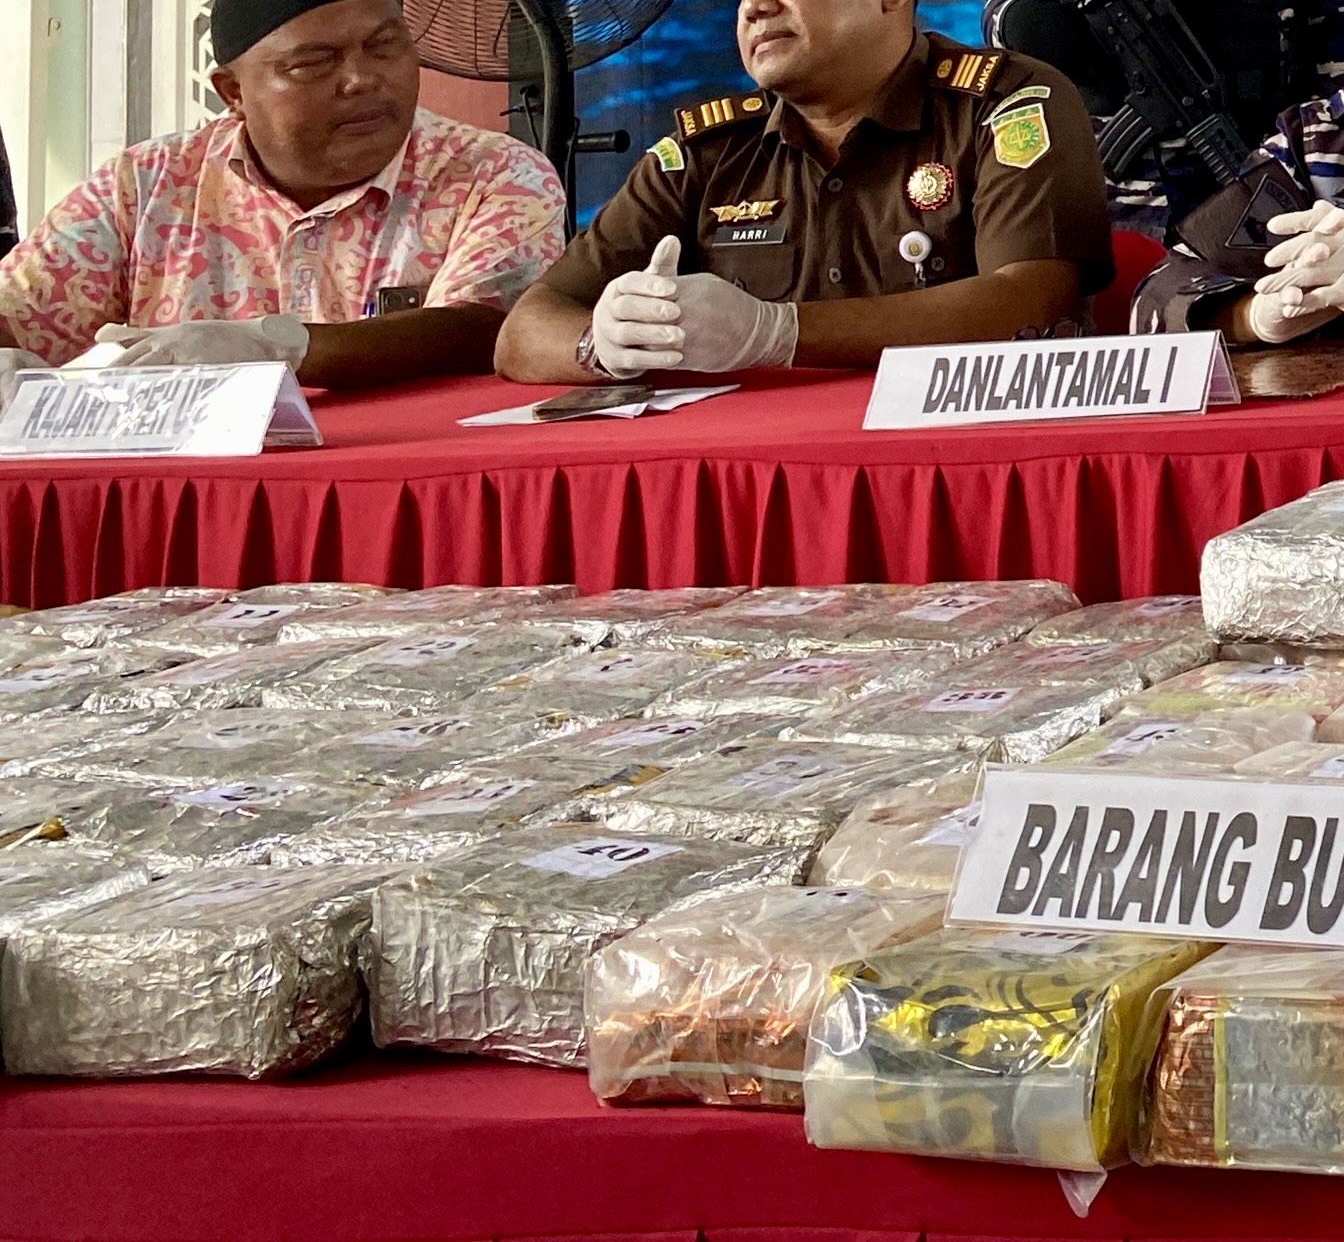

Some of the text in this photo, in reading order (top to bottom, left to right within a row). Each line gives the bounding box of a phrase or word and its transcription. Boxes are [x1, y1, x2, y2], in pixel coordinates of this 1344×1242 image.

[974, 54, 1001, 93] JAKSA
[732, 227, 767, 242] HARRI
[922, 346, 1178, 414] DANLANTAMAL I
[996, 803, 1259, 930] BARANG
